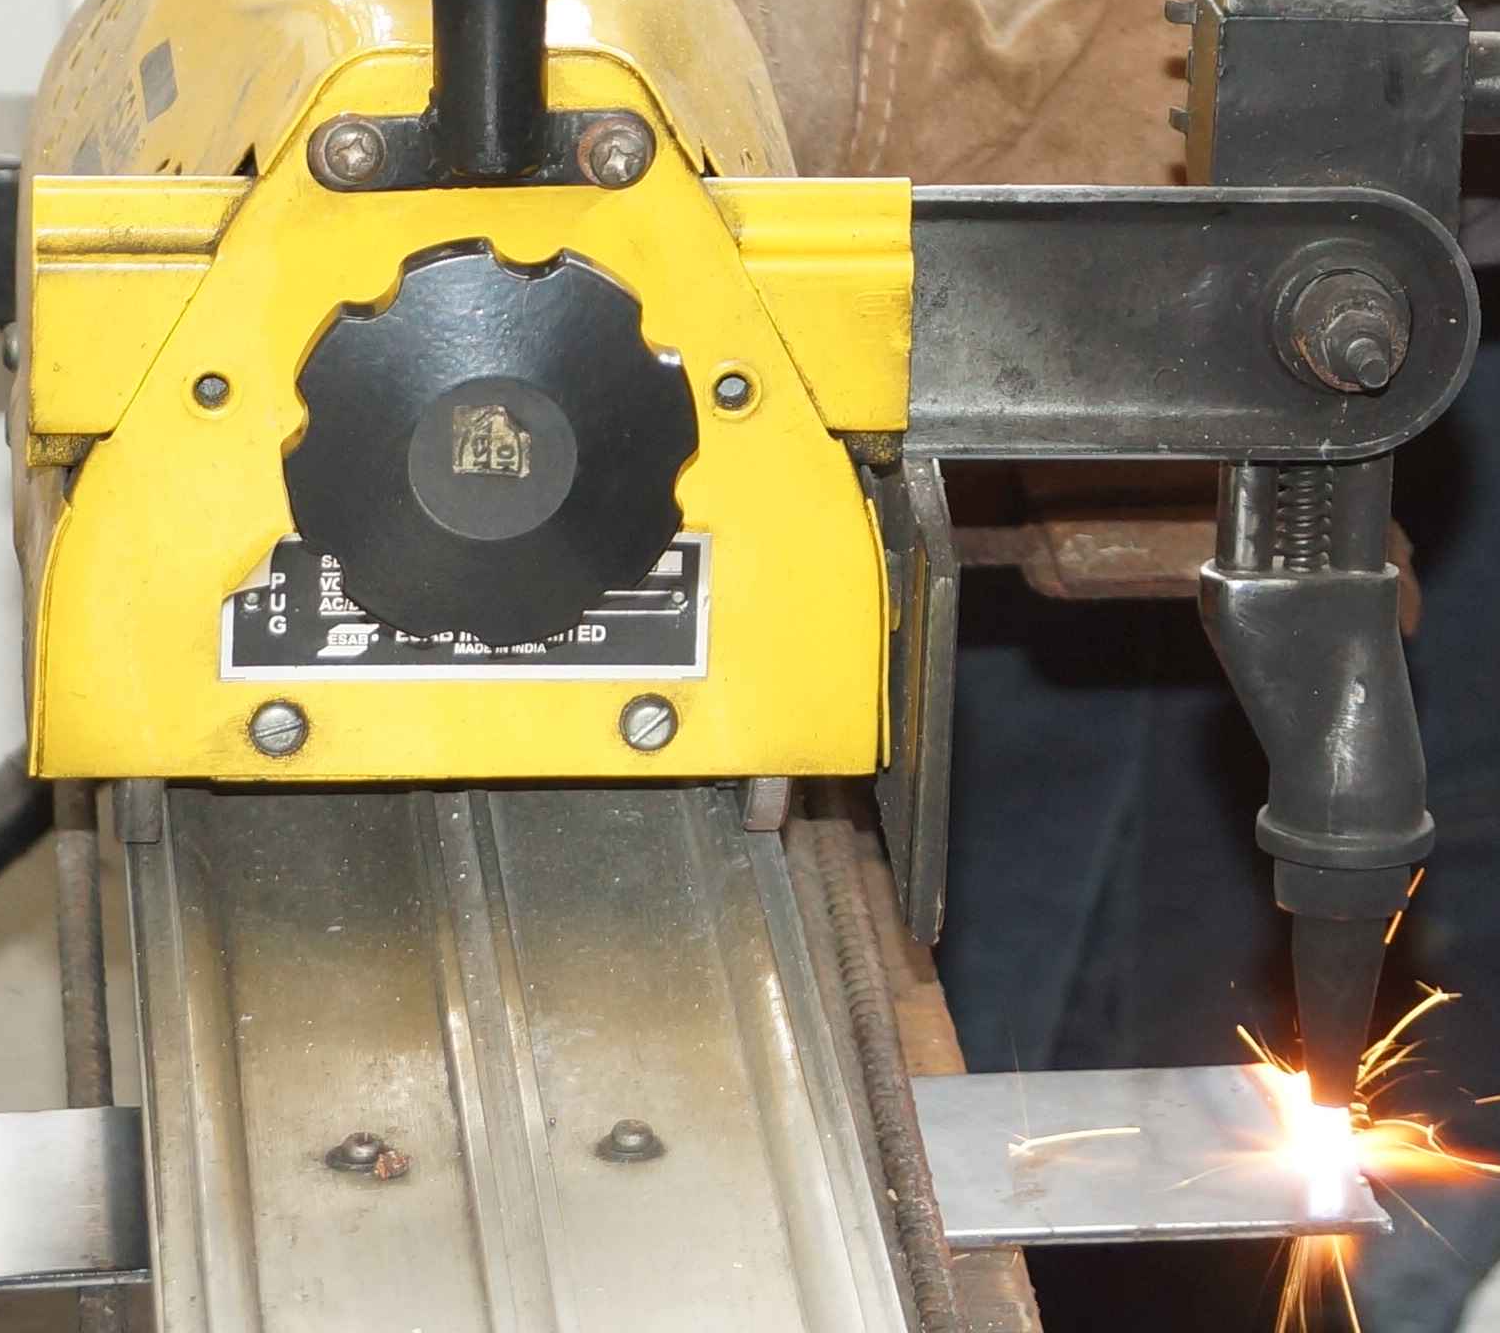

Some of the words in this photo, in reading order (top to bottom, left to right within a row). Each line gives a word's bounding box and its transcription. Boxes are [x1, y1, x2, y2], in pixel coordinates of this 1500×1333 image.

[327, 634, 369, 645] ESAB
[454, 642, 493, 654] MADE
[512, 642, 547, 653] INDIA
